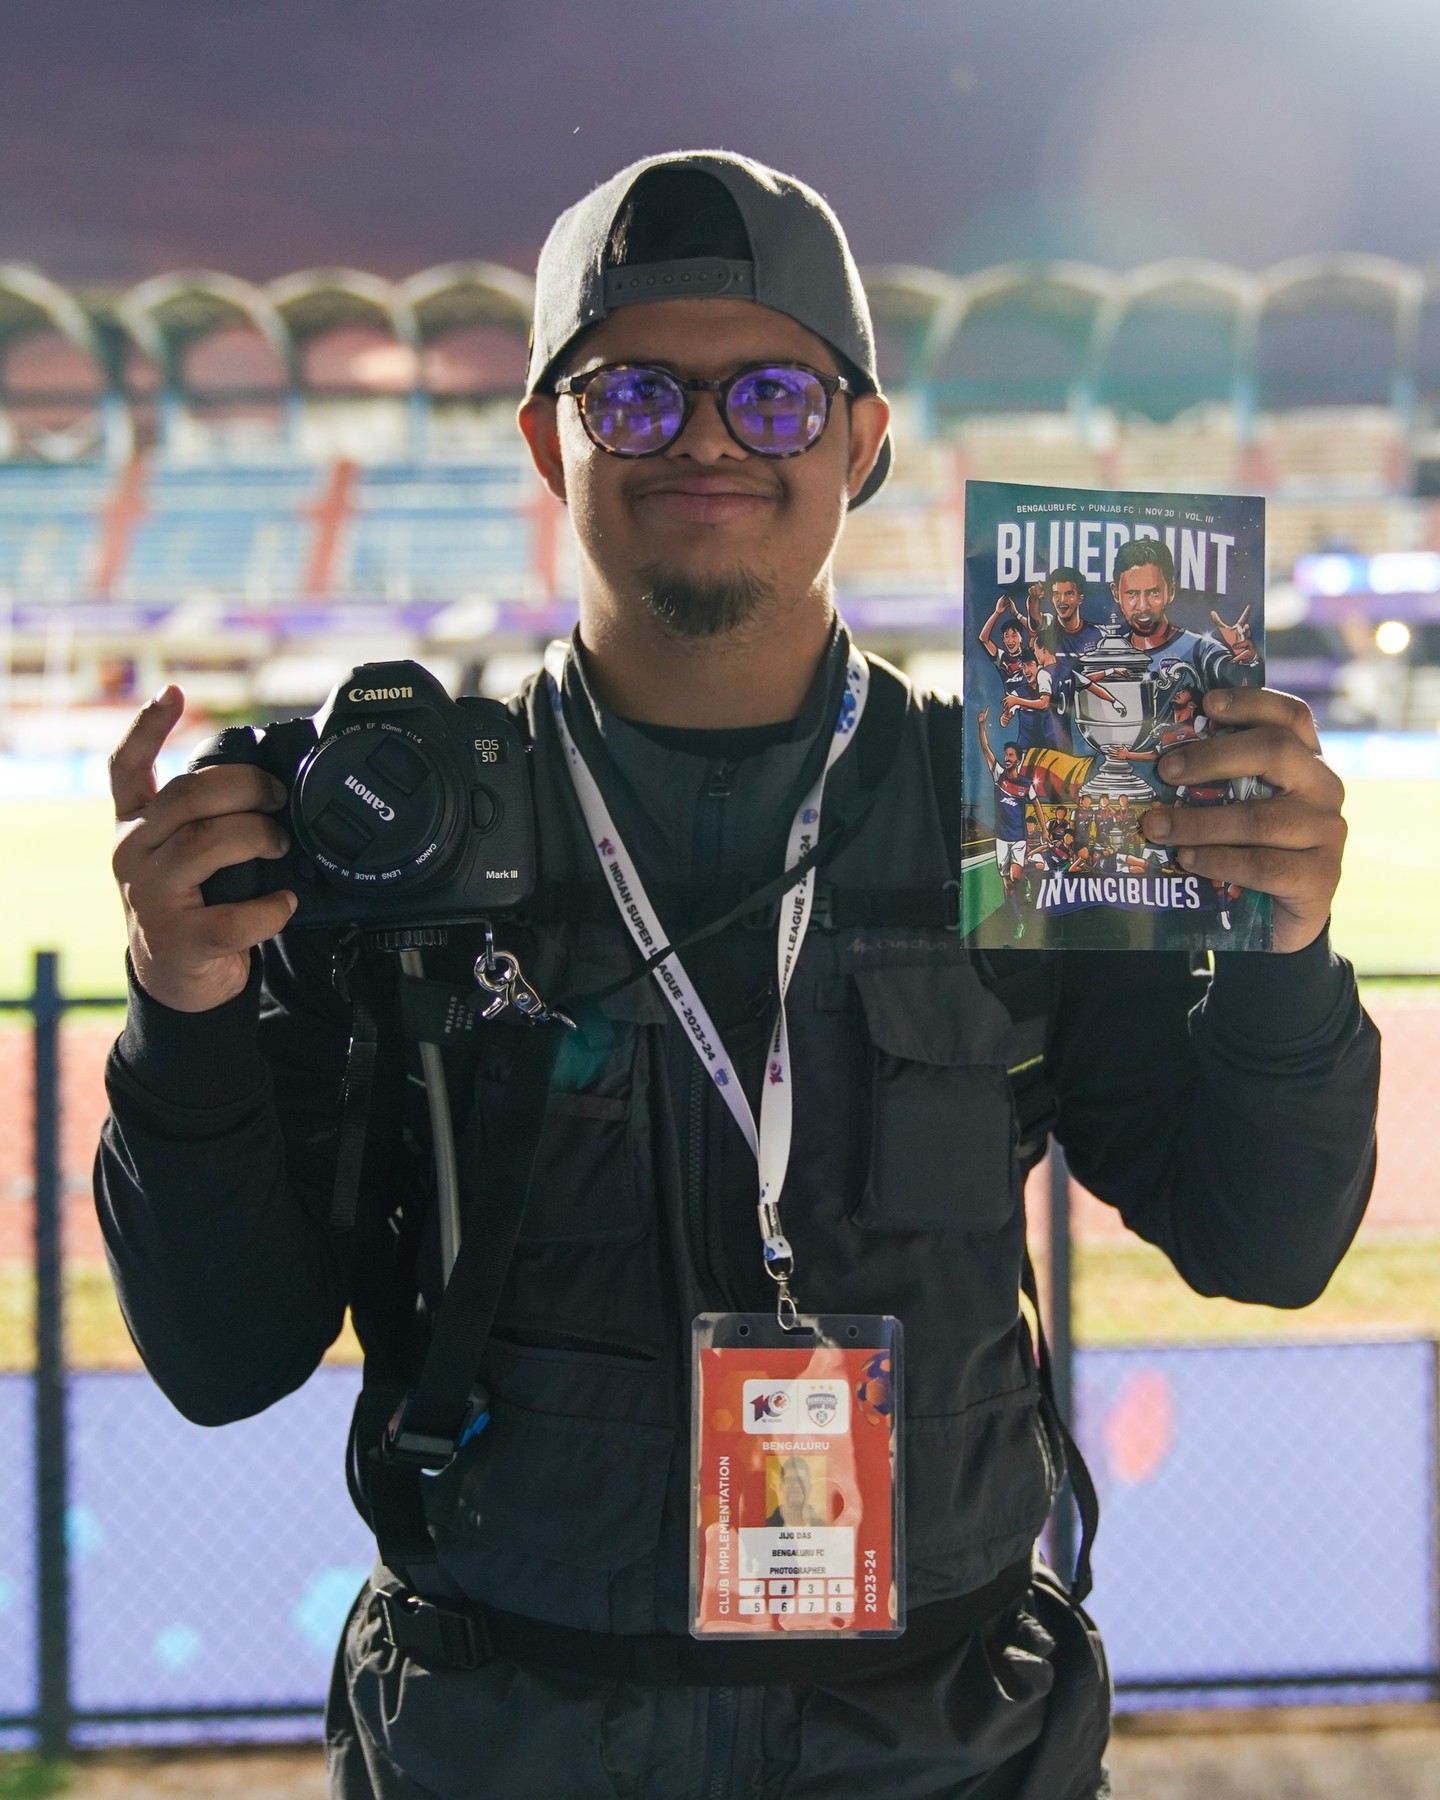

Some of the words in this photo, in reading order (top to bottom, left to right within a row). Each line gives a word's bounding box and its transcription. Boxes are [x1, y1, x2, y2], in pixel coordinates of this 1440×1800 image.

[1016, 504, 1065, 514] BENGALURU
[1066, 504, 1077, 512] FC
[1088, 504, 1121, 514] PUNJAB
[1124, 506, 1134, 514] FC
[1145, 507, 1163, 517] NOV
[1164, 509, 1175, 518] 30
[1185, 511, 1204, 523] VOL.
[1205, 514, 1214, 524] III
[348, 686, 413, 703] Canon
[316, 733, 338, 753] CANON
[342, 724, 361, 736] LENS
[366, 722, 376, 730] EF
[381, 723, 403, 734] 50mm
[406, 731, 423, 745] 1:1.4
[474, 739, 500, 751] EOS
[481, 751, 498, 763] 5D
[344, 775, 396, 822] Canon
[415, 843, 438, 866] CANON
[316, 853, 338, 871] JAPAN
[341, 868, 350, 877] IN
[355, 872, 376, 881] MADE
[382, 869, 402, 880] LENS
[485, 870, 510, 879] Mark
[510, 869, 518, 879] III
[1036, 877, 1200, 910] INVINCIBLUES
[787, 896, 806, 954] LEAGUE
[609, 861, 634, 905] INDIAN
[626, 901, 654, 948] SUPER
[648, 947, 684, 1000] LAGUE
[683, 1008, 717, 1062] 2023-24
[762, 1441, 830, 1451] BENGALURU
[719, 1456, 730, 1574] IMPLEMENTATION
[778, 1532, 795, 1540] JIJO
[796, 1532, 812, 1540] DAS
[771, 1549, 814, 1557] BENGALURU
[815, 1549, 825, 1557] FC
[769, 1566, 826, 1575] PHOTOGRAPHER
[864, 1549, 877, 1613] 2023-24
[808, 1584, 814, 1594] 3
[835, 1583, 841, 1594] 4
[719, 1578, 730, 1615] CLUB
[754, 1602, 760, 1613] 5
[781, 1602, 787, 1612] 6
[808, 1602, 814, 1612] 7
[835, 1601, 842, 1612] 8
